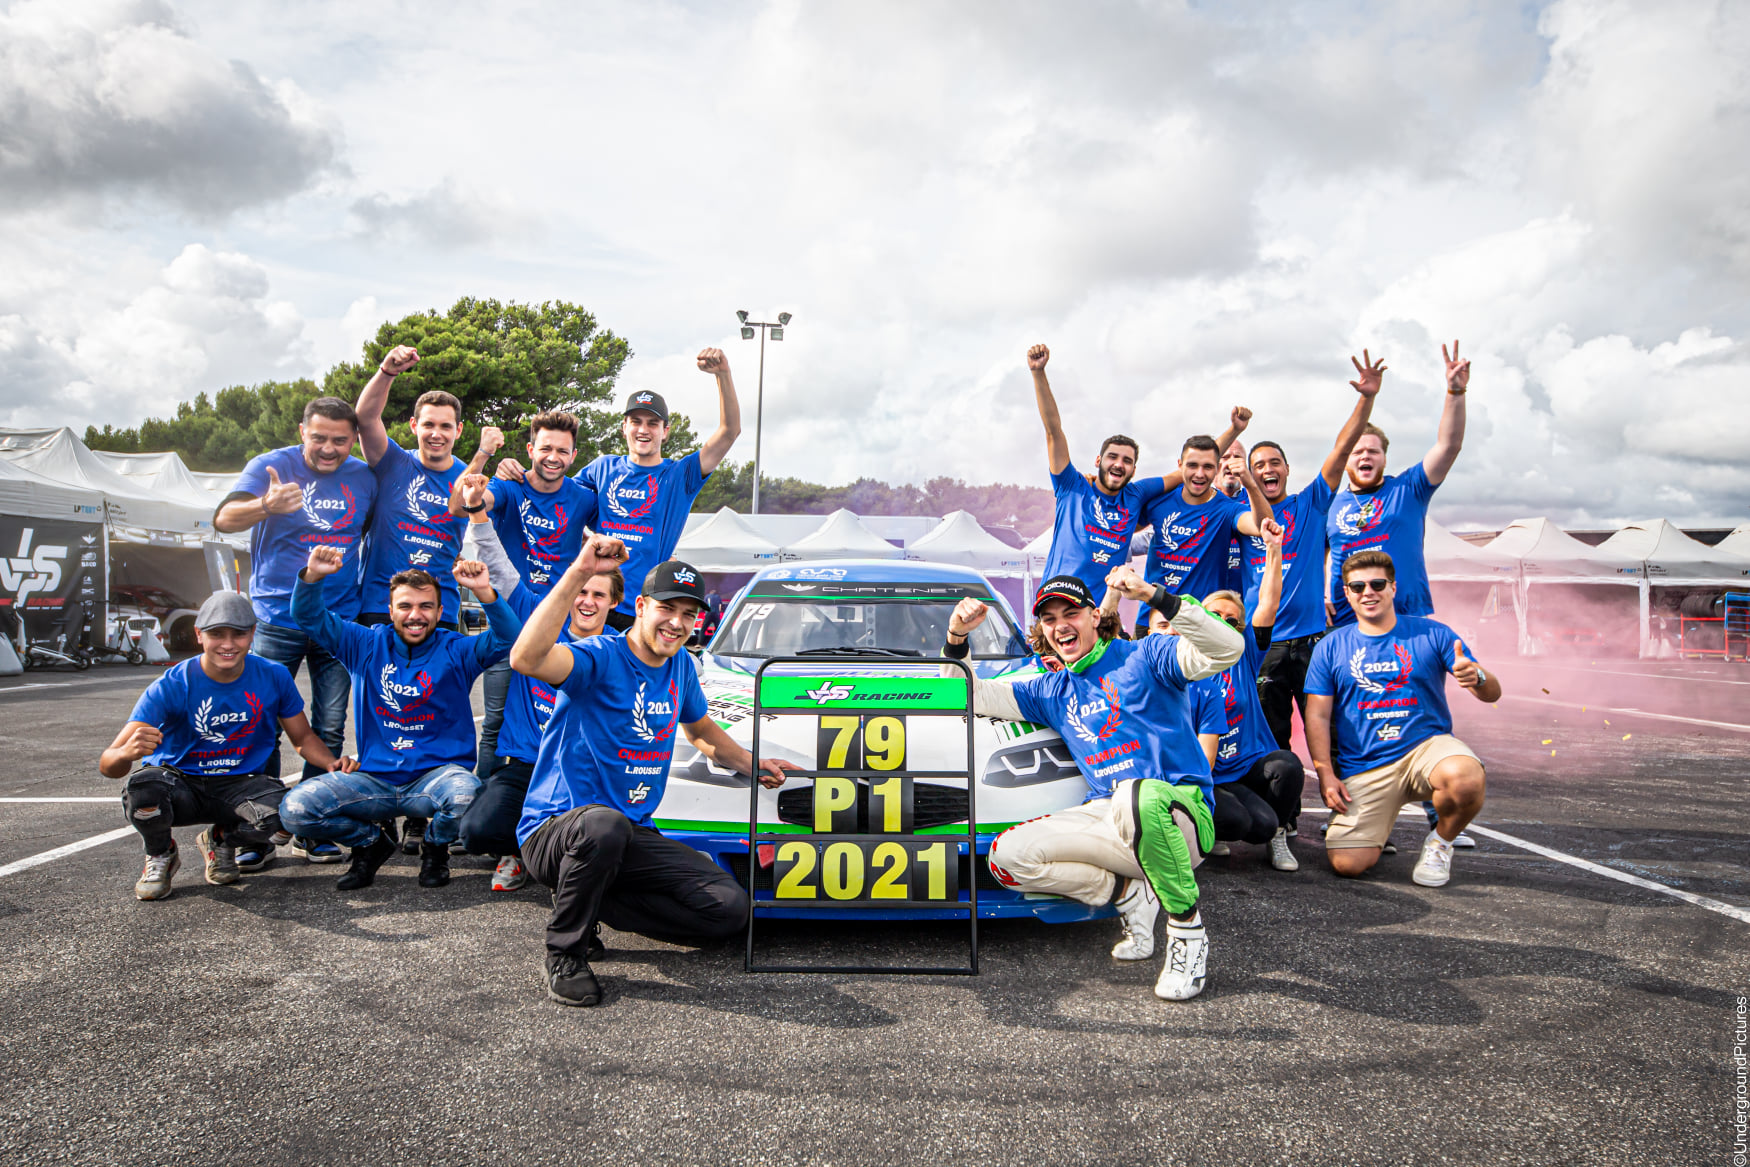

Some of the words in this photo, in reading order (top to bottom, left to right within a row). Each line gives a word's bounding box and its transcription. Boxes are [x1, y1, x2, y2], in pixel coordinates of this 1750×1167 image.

[419, 491, 449, 506] 2021
[618, 489, 646, 500] 2021
[314, 499, 346, 510] 2021
[526, 515, 556, 530] 2021
[601, 520, 653, 534] CHAMPION
[398, 521, 454, 541] CHAMPION
[300, 534, 353, 544] CHAMPION
[404, 534, 443, 549] L.ROUSSET
[1341, 533, 1389, 551] CHAMPION
[1156, 550, 1199, 564] CHAMPION
[1043, 581, 1085, 596] YOKOHAMA
[1364, 661, 1399, 673] 2021
[388, 680, 421, 697] 2021
[852, 692, 933, 701] RACING
[1357, 696, 1418, 711] CHAMPION
[211, 711, 249, 727] 2021
[376, 706, 434, 724] CHAMPION
[1366, 710, 1410, 720] L.ROUSSET
[820, 716, 905, 771] 79
[618, 748, 671, 762] CHAMPION
[625, 765, 662, 775] L.ROUSSET
[775, 841, 947, 900] 2021
